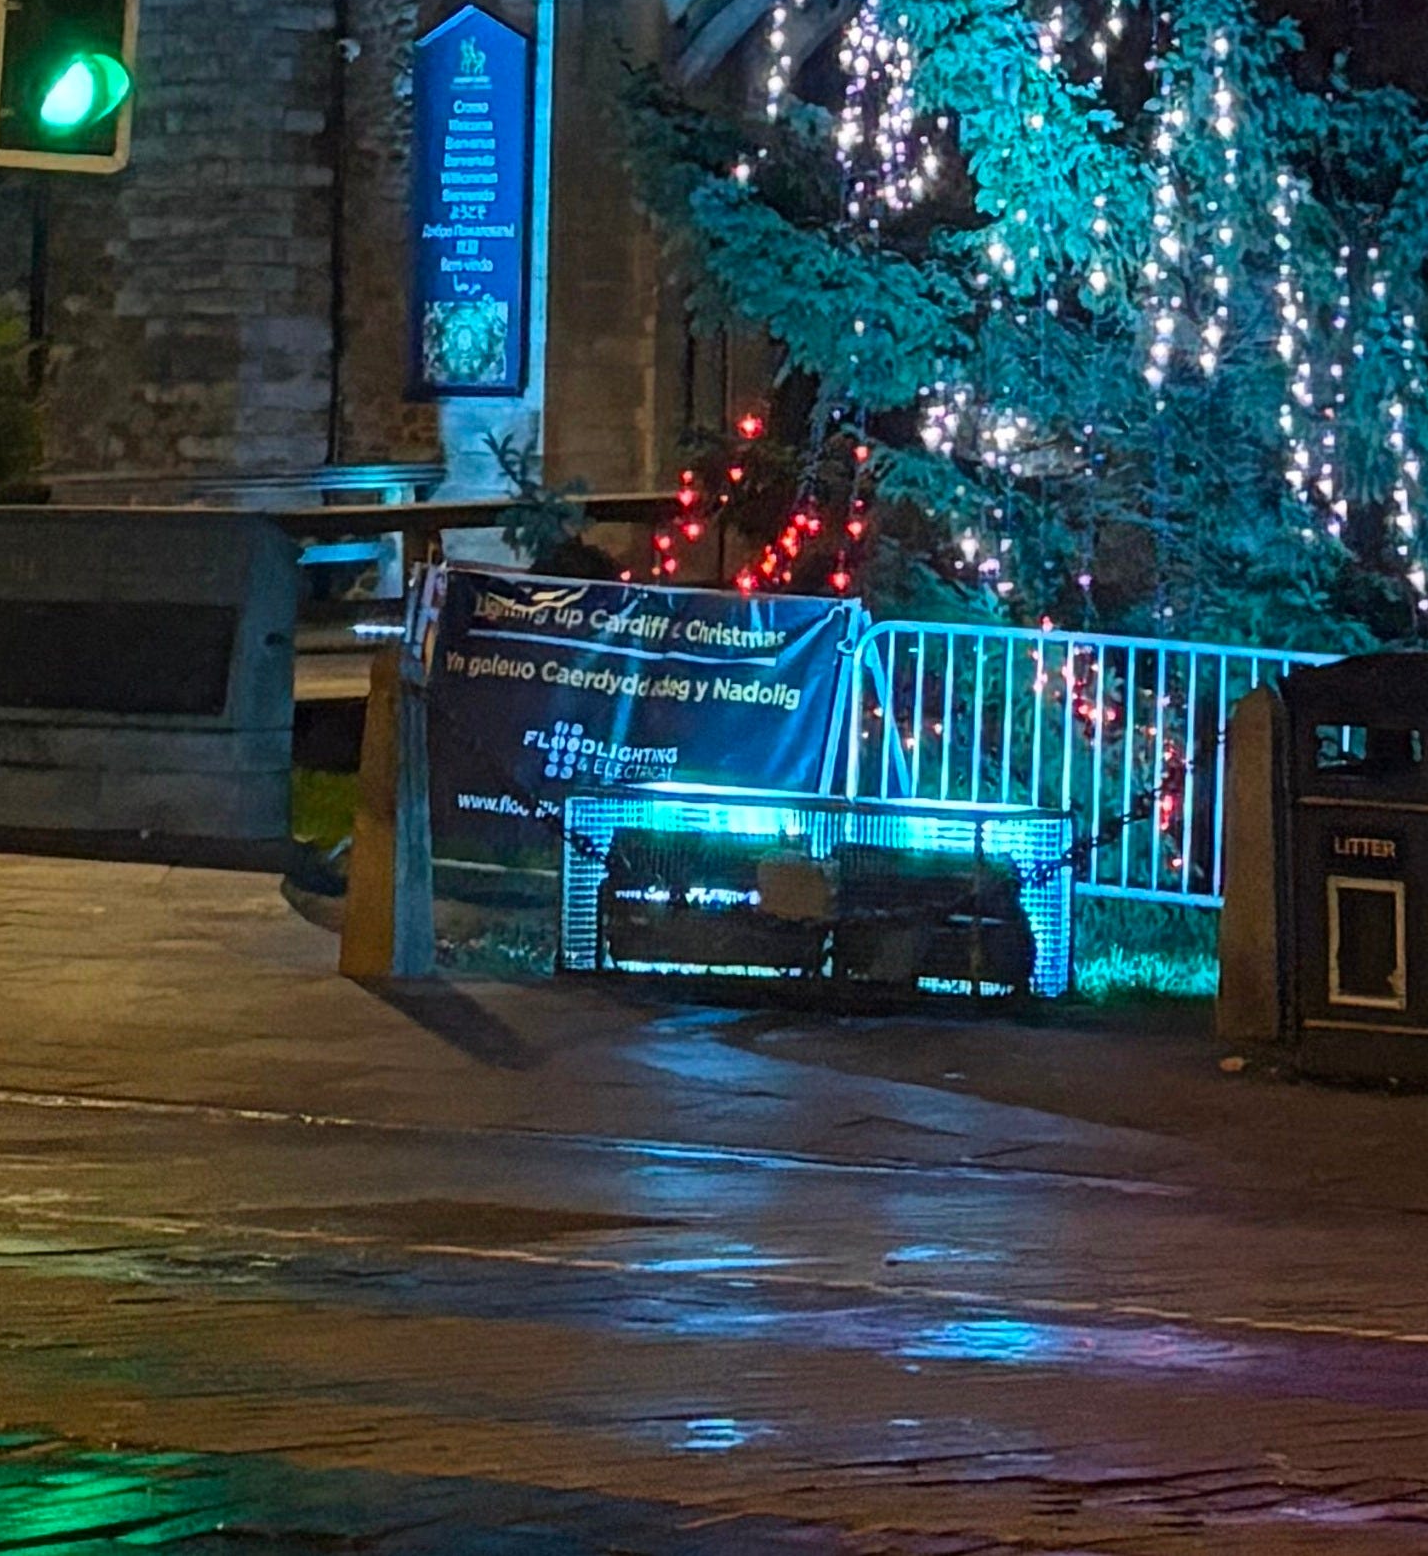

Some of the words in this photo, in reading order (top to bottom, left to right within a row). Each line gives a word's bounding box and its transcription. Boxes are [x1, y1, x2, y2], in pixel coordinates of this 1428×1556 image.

[554, 607, 584, 629] up
[590, 608, 671, 640] Cardiff
[686, 619, 787, 649] Christmas
[446, 651, 465, 673] Yn
[468, 653, 536, 680] goleuo
[541, 661, 651, 698] Caerdydd
[693, 679, 709, 703] y
[712, 677, 801, 711] Nadolig
[1334, 836, 1396, 858] LITTER
